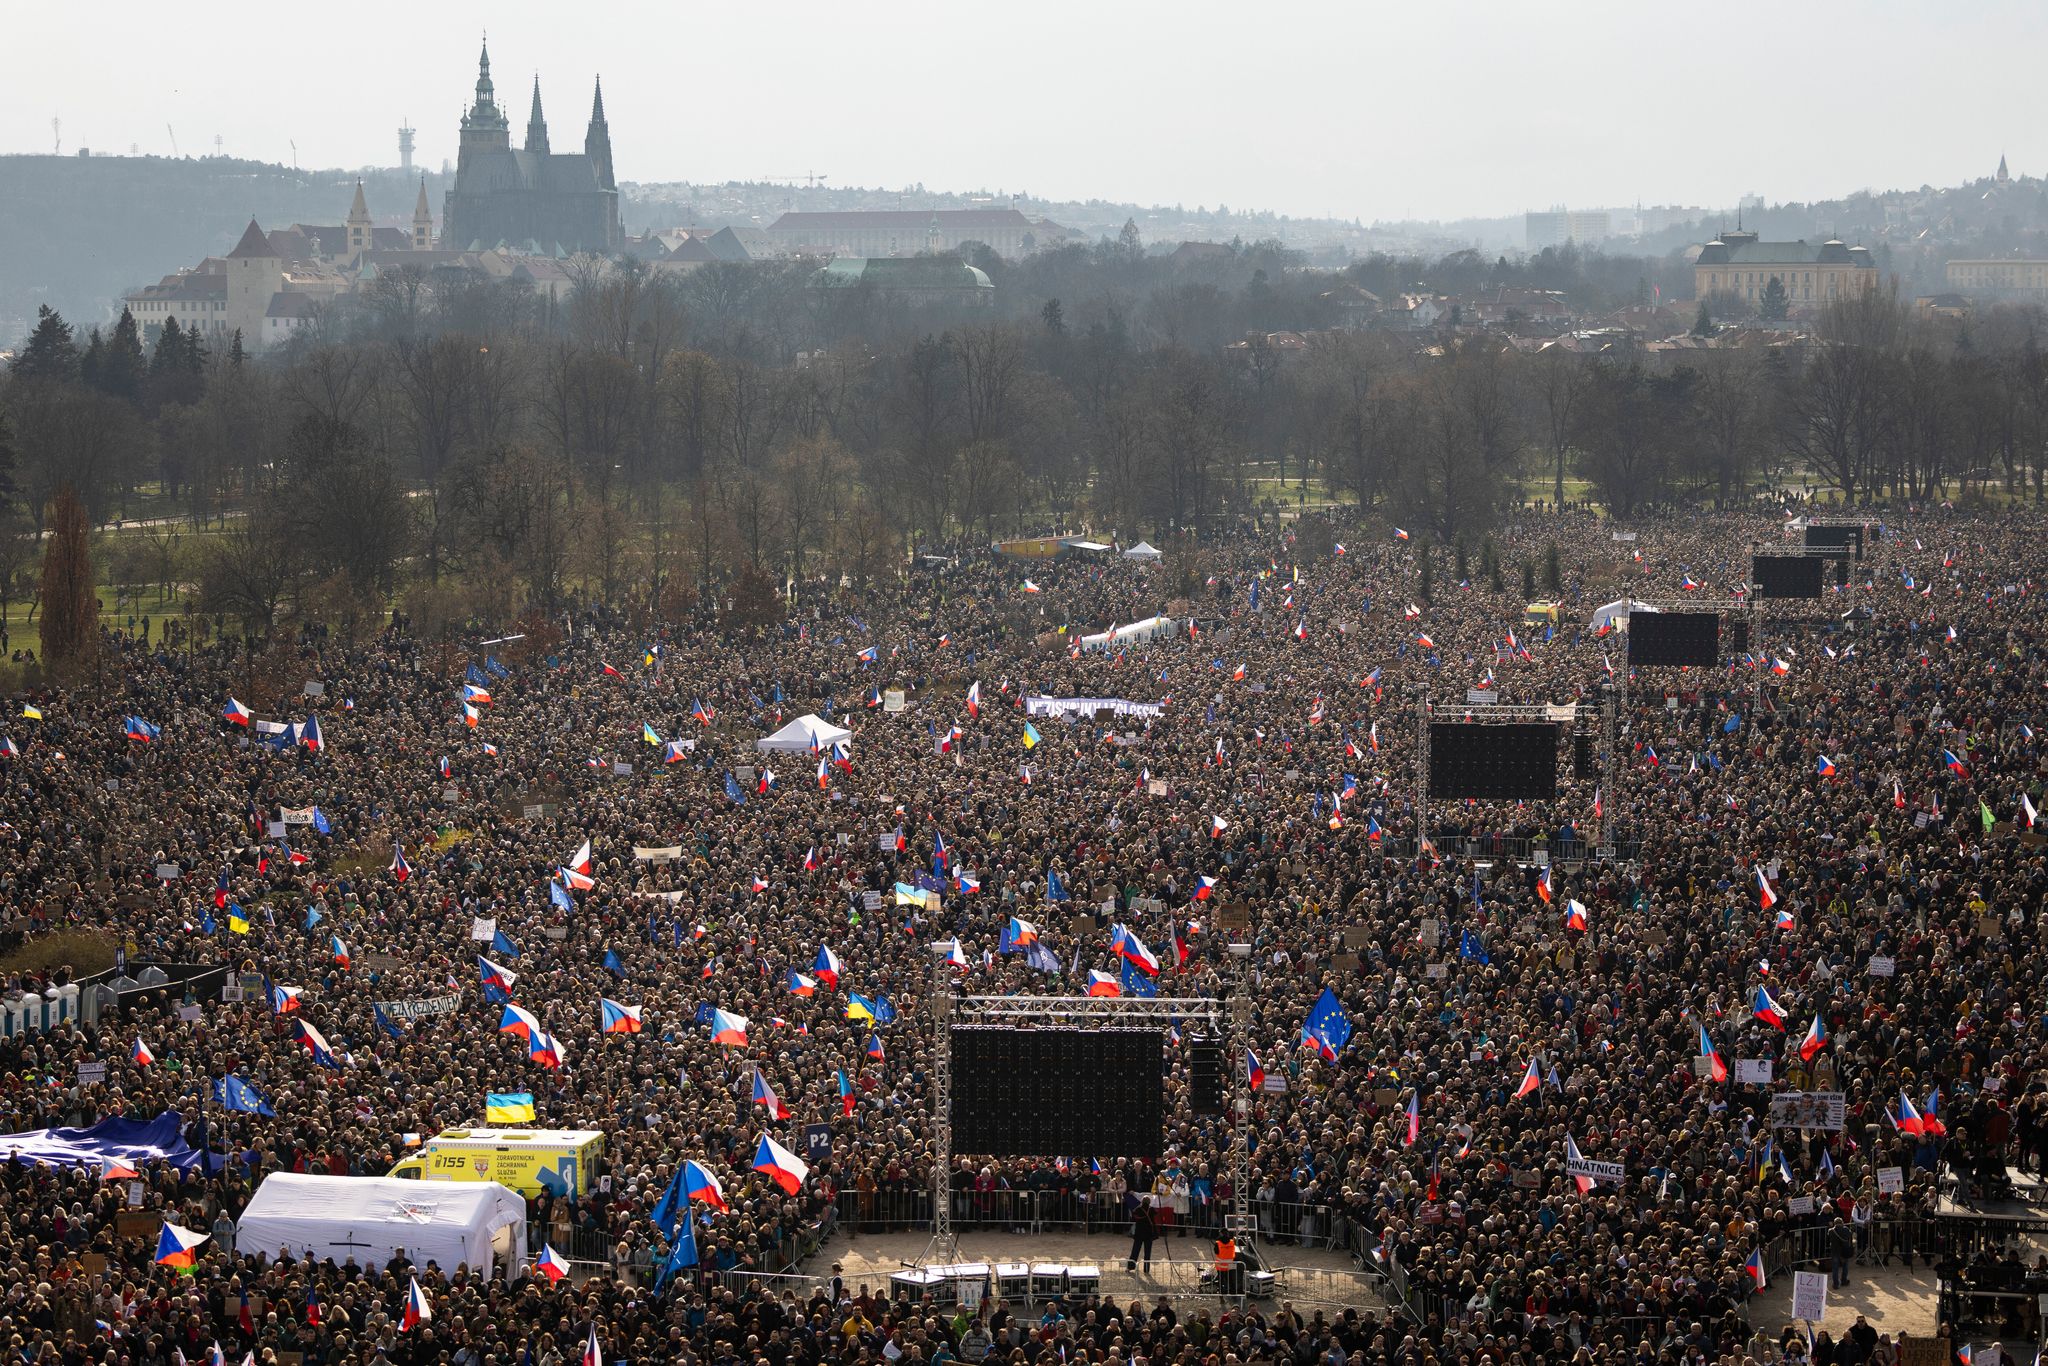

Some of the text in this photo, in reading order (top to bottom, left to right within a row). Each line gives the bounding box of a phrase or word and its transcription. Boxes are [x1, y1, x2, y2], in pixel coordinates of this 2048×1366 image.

[810, 1133, 829, 1148] P2
[443, 1157, 466, 1167] 155
[1567, 1160, 1623, 1176] HNÁTNICE
